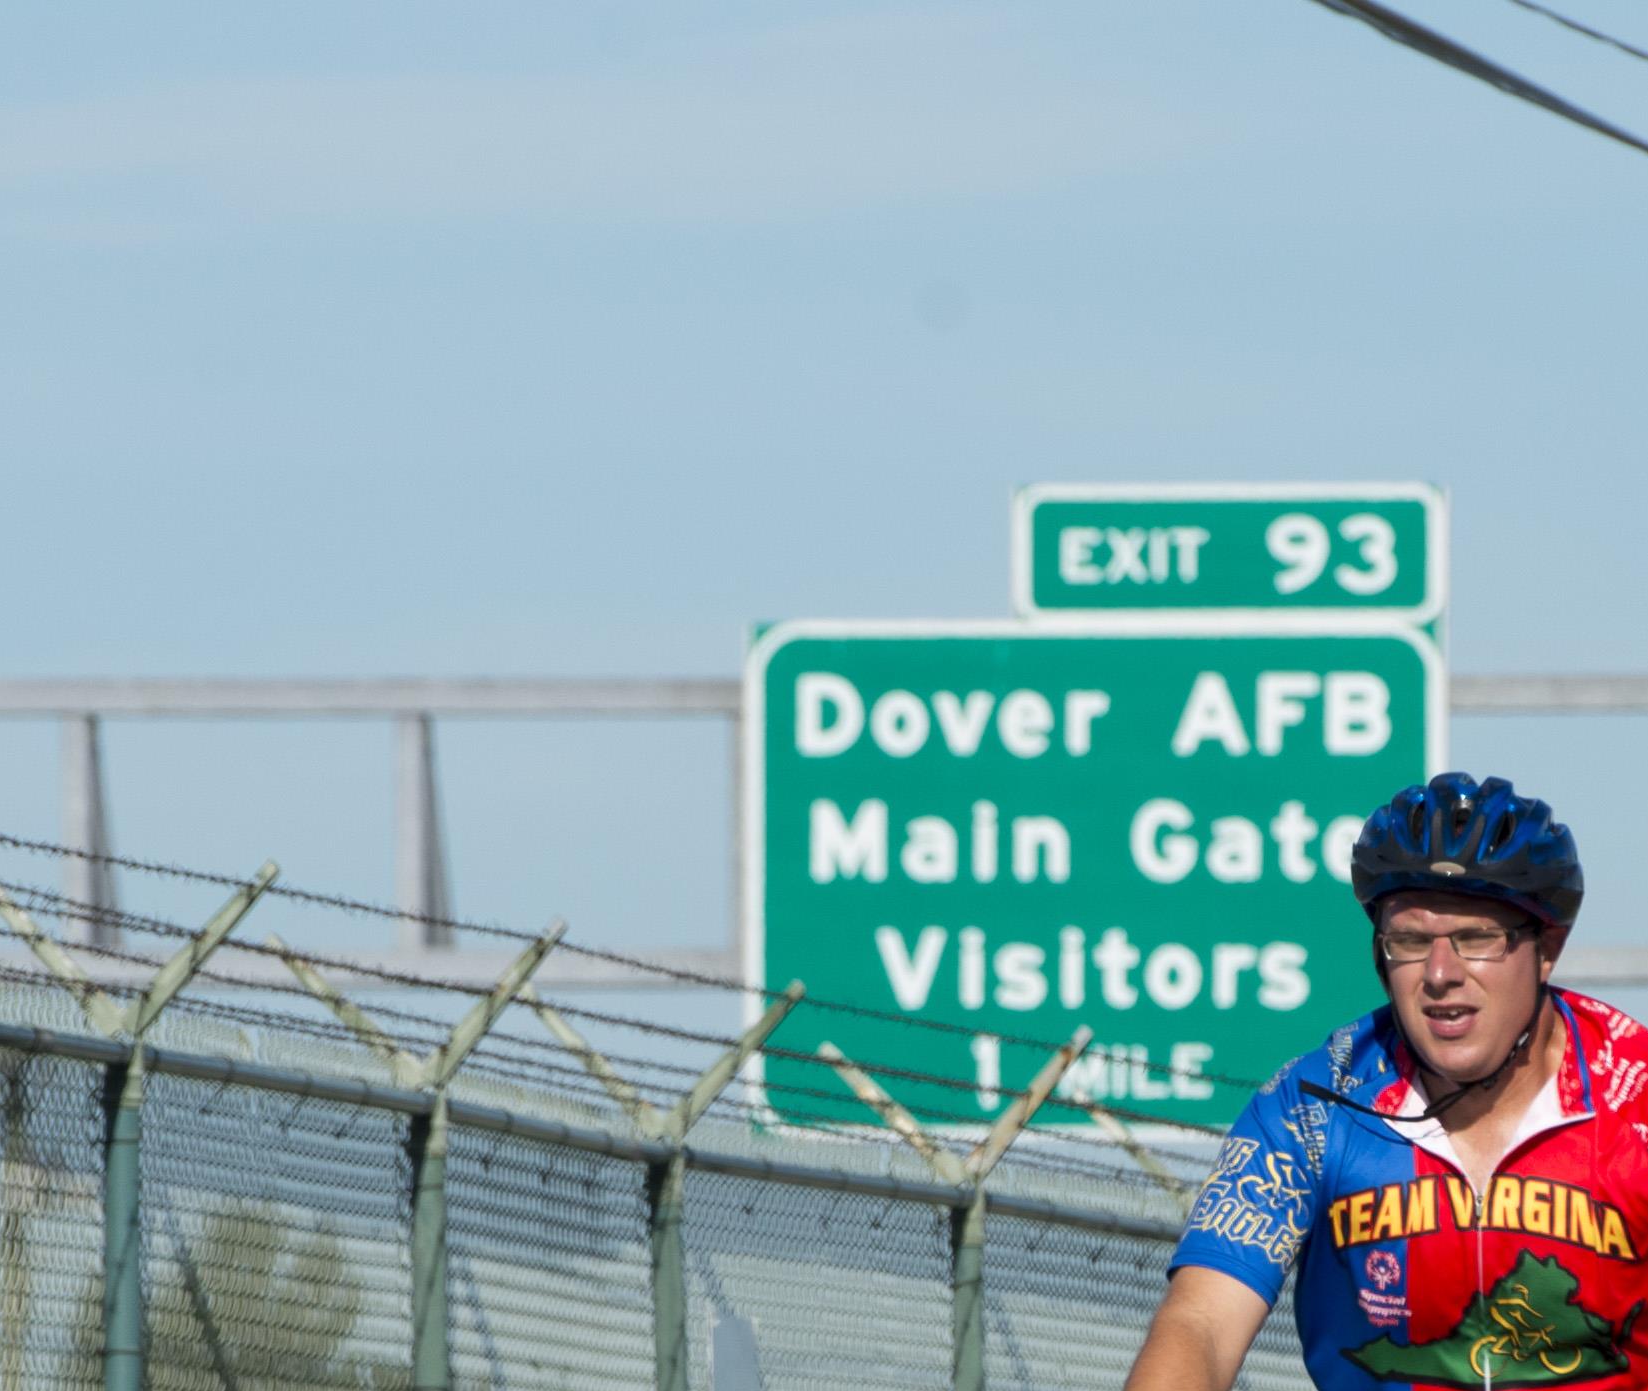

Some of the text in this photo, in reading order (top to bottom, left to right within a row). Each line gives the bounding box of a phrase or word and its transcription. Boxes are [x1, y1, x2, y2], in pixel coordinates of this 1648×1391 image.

[1058, 512, 1398, 596] EXIT 93
[794, 670, 1393, 759] Dover AFB
[809, 798, 1071, 884] Main
[875, 925, 1311, 1012] Visitors
[970, 1033, 1001, 1112] 1
[1054, 1042, 1214, 1101] MILE
[1189, 1181, 1302, 1276] EAGLE
[1328, 1173, 1639, 1264] TEAM VIRGINA
